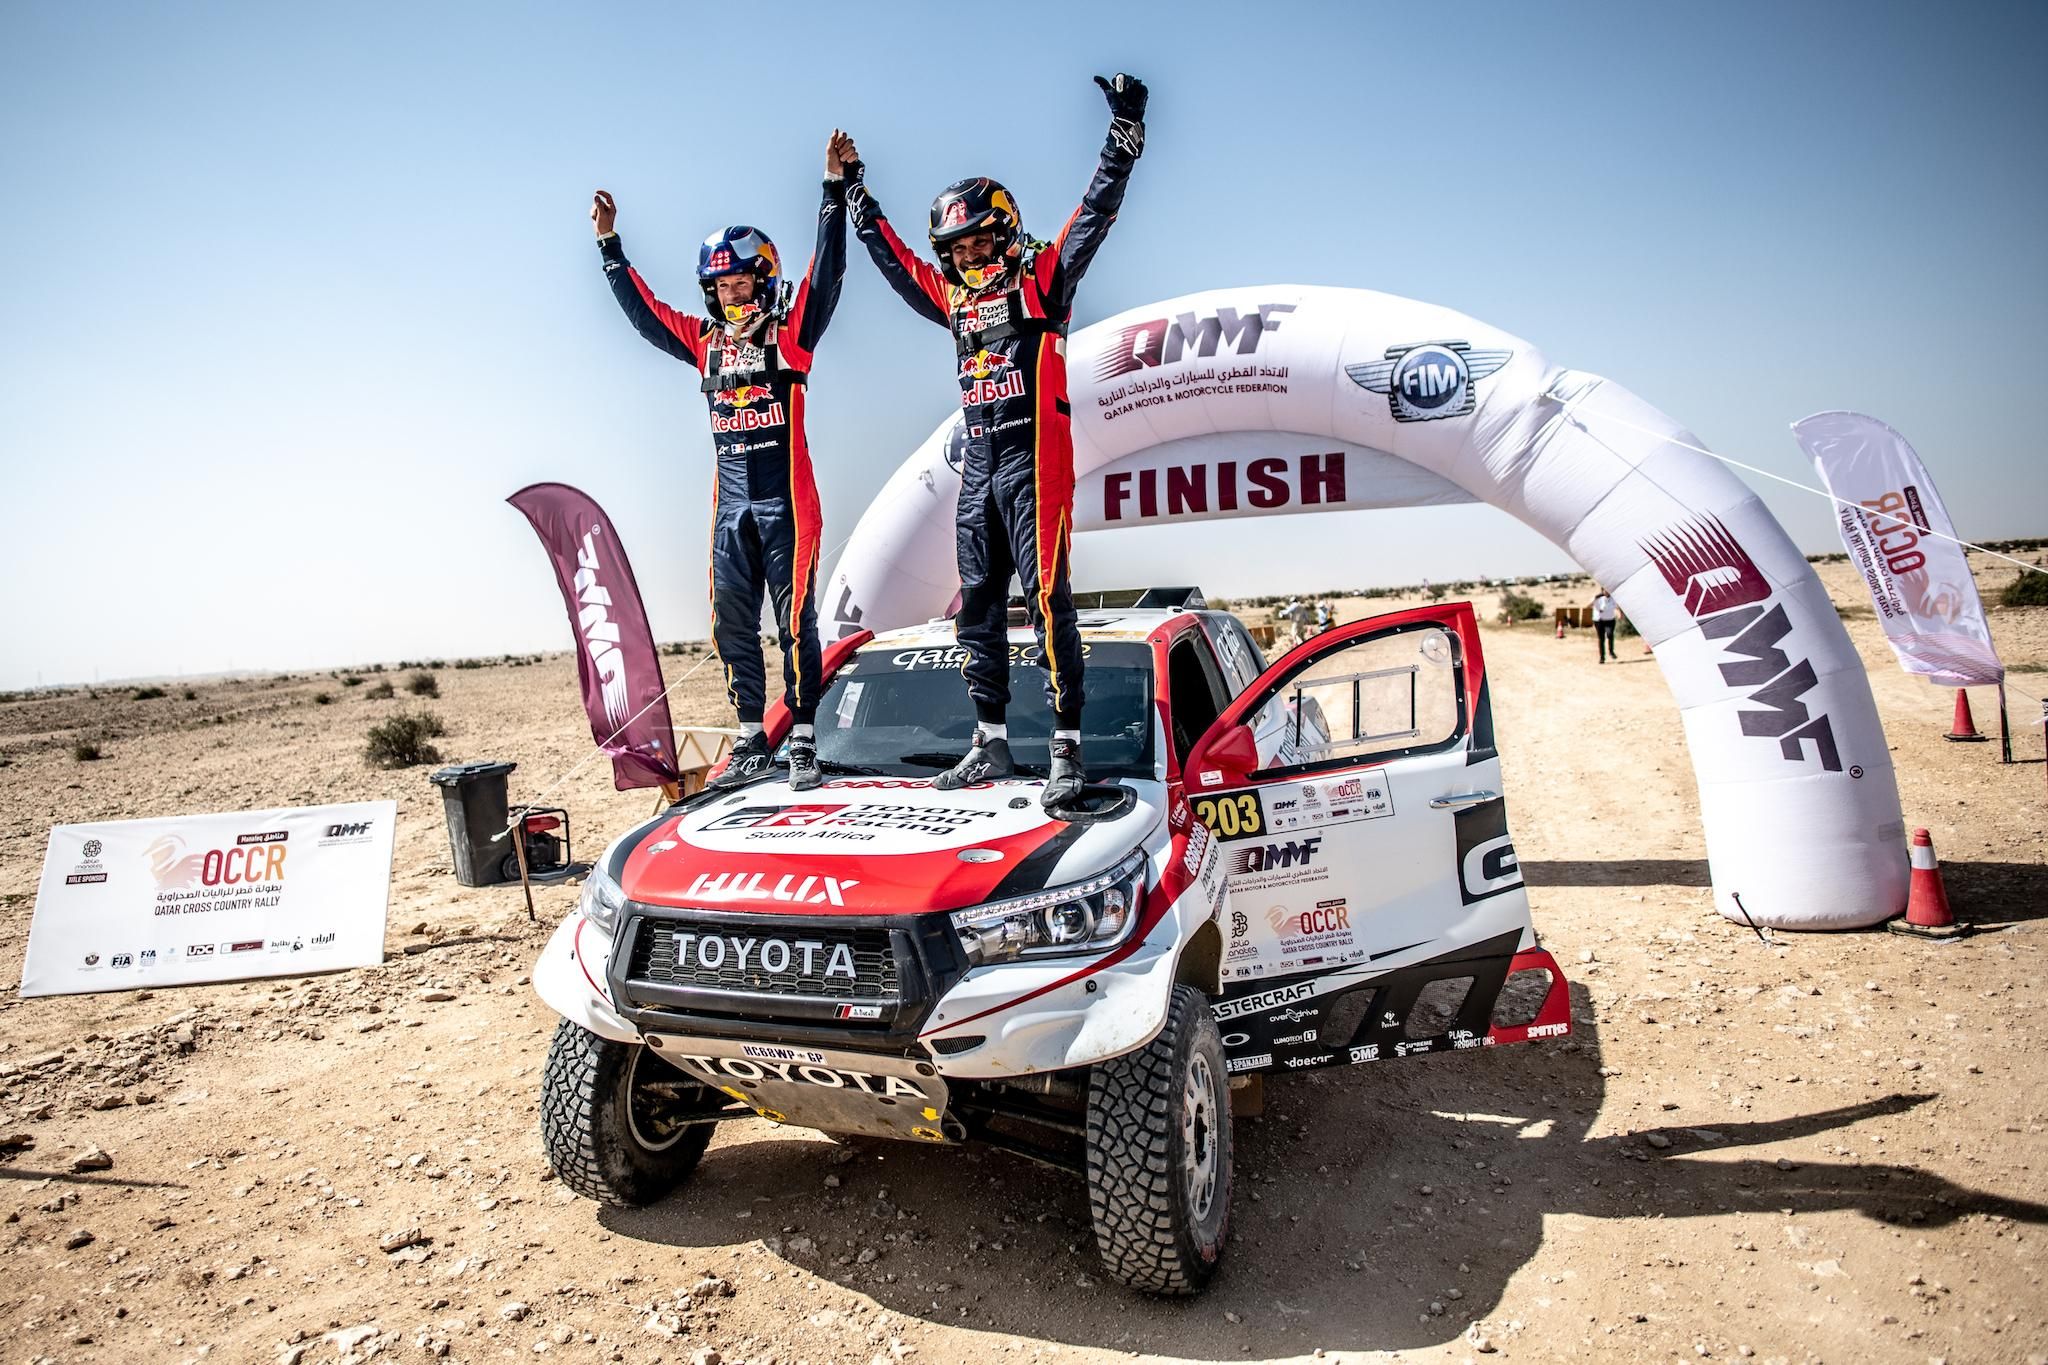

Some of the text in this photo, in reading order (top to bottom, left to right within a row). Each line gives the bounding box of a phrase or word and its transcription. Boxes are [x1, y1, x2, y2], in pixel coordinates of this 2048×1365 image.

[979, 309, 1008, 321] GAZO
[1092, 304, 1297, 384] QMMF
[1217, 366, 1257, 381] القطري
[1403, 363, 1457, 398] FIM
[963, 371, 1025, 407] ed Bull
[1104, 384, 1288, 420] QATAR MOTOR & MOTORCYCLE FEDERATION
[711, 402, 785, 433] Red Bull
[1104, 452, 1346, 522] FINISH
[1635, 509, 1842, 771] QMMF
[1367, 791, 1380, 799] FIA
[838, 811, 973, 825] GAZOO
[860, 804, 997, 818] TOYOTA
[1197, 794, 1260, 837] 203
[322, 821, 373, 837] QMMF
[822, 818, 957, 835] Racing
[745, 831, 876, 841] South Africa
[1228, 837, 1322, 875] QMMF
[235, 887, 253, 897] قطر
[255, 885, 282, 894] بطولة
[685, 872, 860, 906] HILUX
[154, 896, 280, 916] QATAR CROSS COUNTRY RALLY
[1282, 938, 1353, 954] QATAR CROSS COUNTRY RALLY
[112, 956, 131, 966] FIA
[141, 950, 156, 958] FIA
[672, 933, 857, 978] TOYOTA
[1237, 968, 1250, 976] FIA
[1212, 982, 1315, 1018] ASTERCRAFT
[1527, 1023, 1568, 1037] SMITHS
[807, 1052, 823, 1063] GP
[1350, 1047, 1379, 1062] OMP
[680, 1054, 929, 1100] TOYOTA
